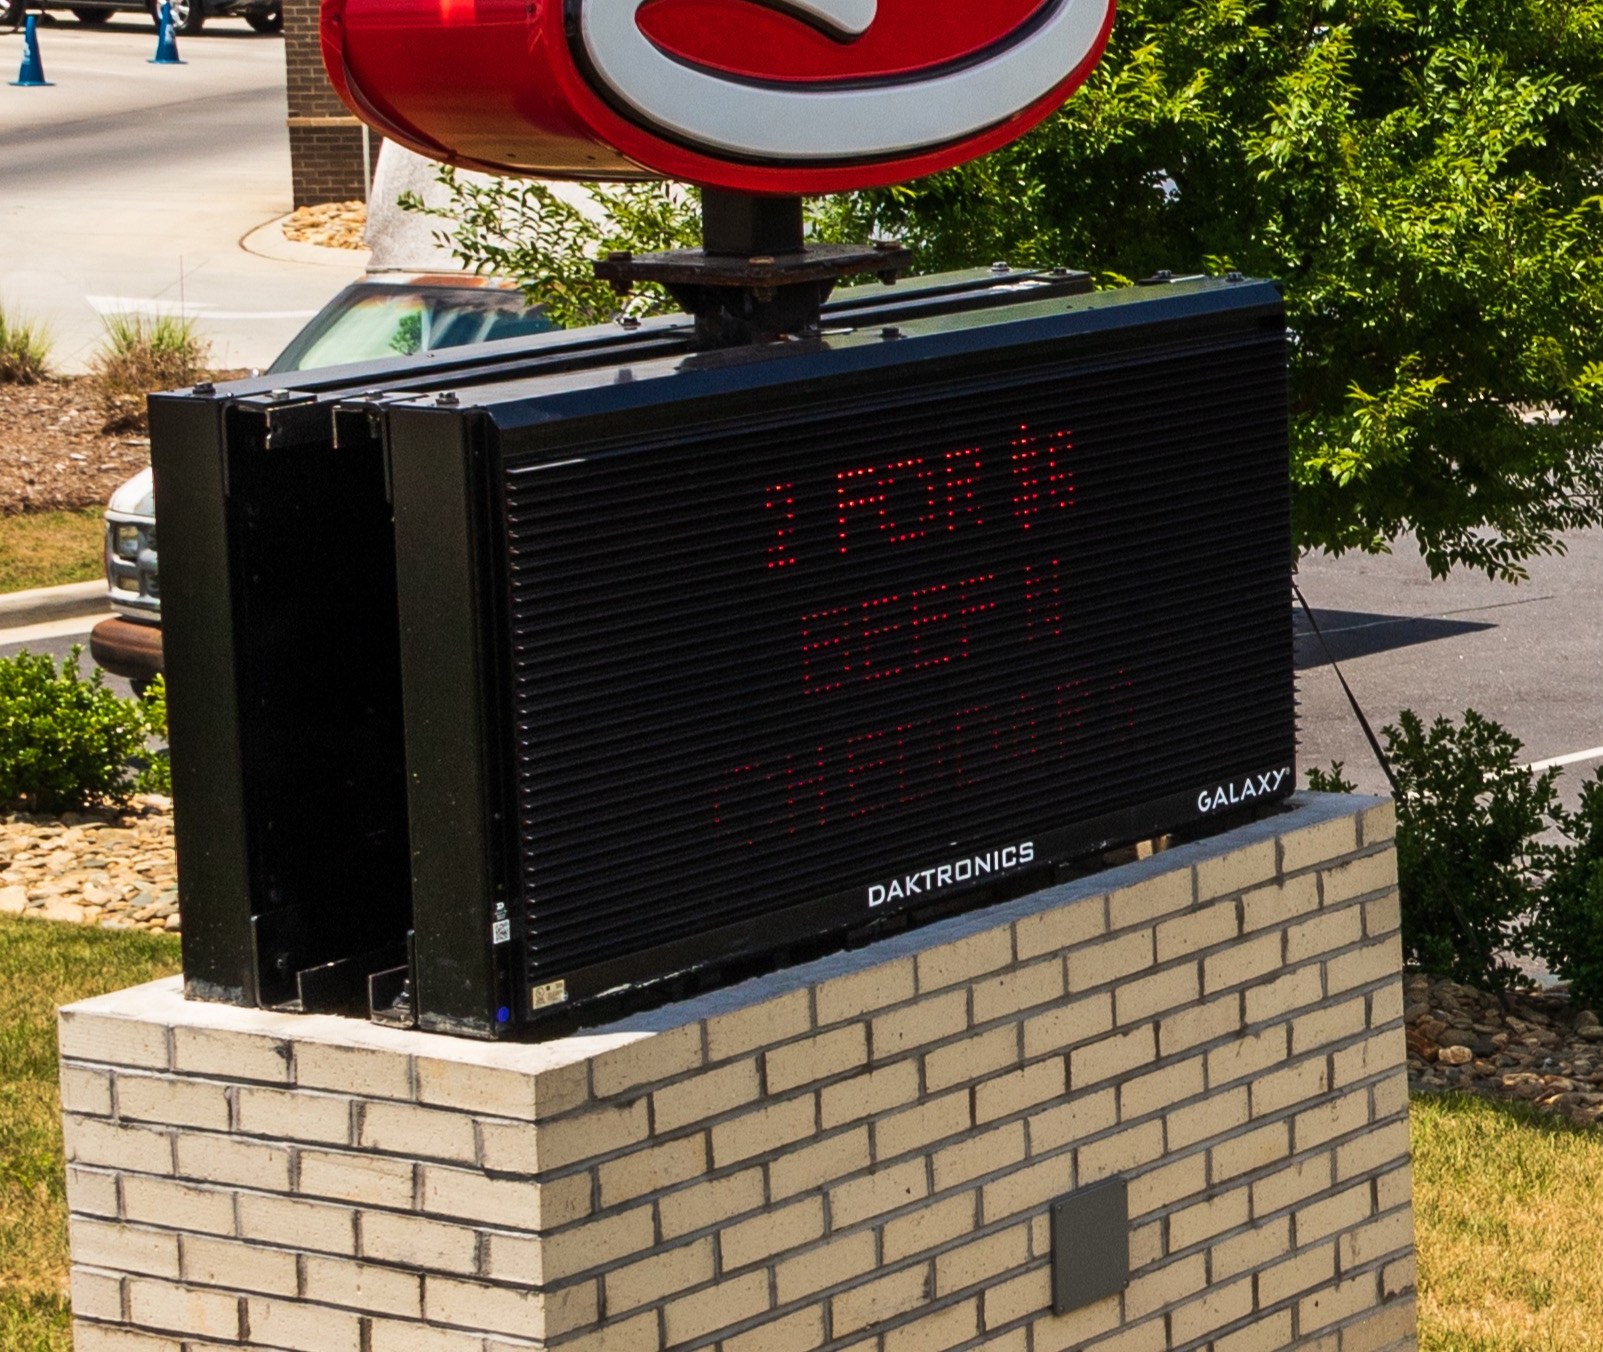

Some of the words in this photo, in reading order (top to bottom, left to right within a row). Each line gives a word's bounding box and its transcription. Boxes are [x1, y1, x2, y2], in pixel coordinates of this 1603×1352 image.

[837, 446, 982, 553] FOR
[802, 572, 996, 696] BEEF
[867, 841, 1035, 908] DAKTRONICS
